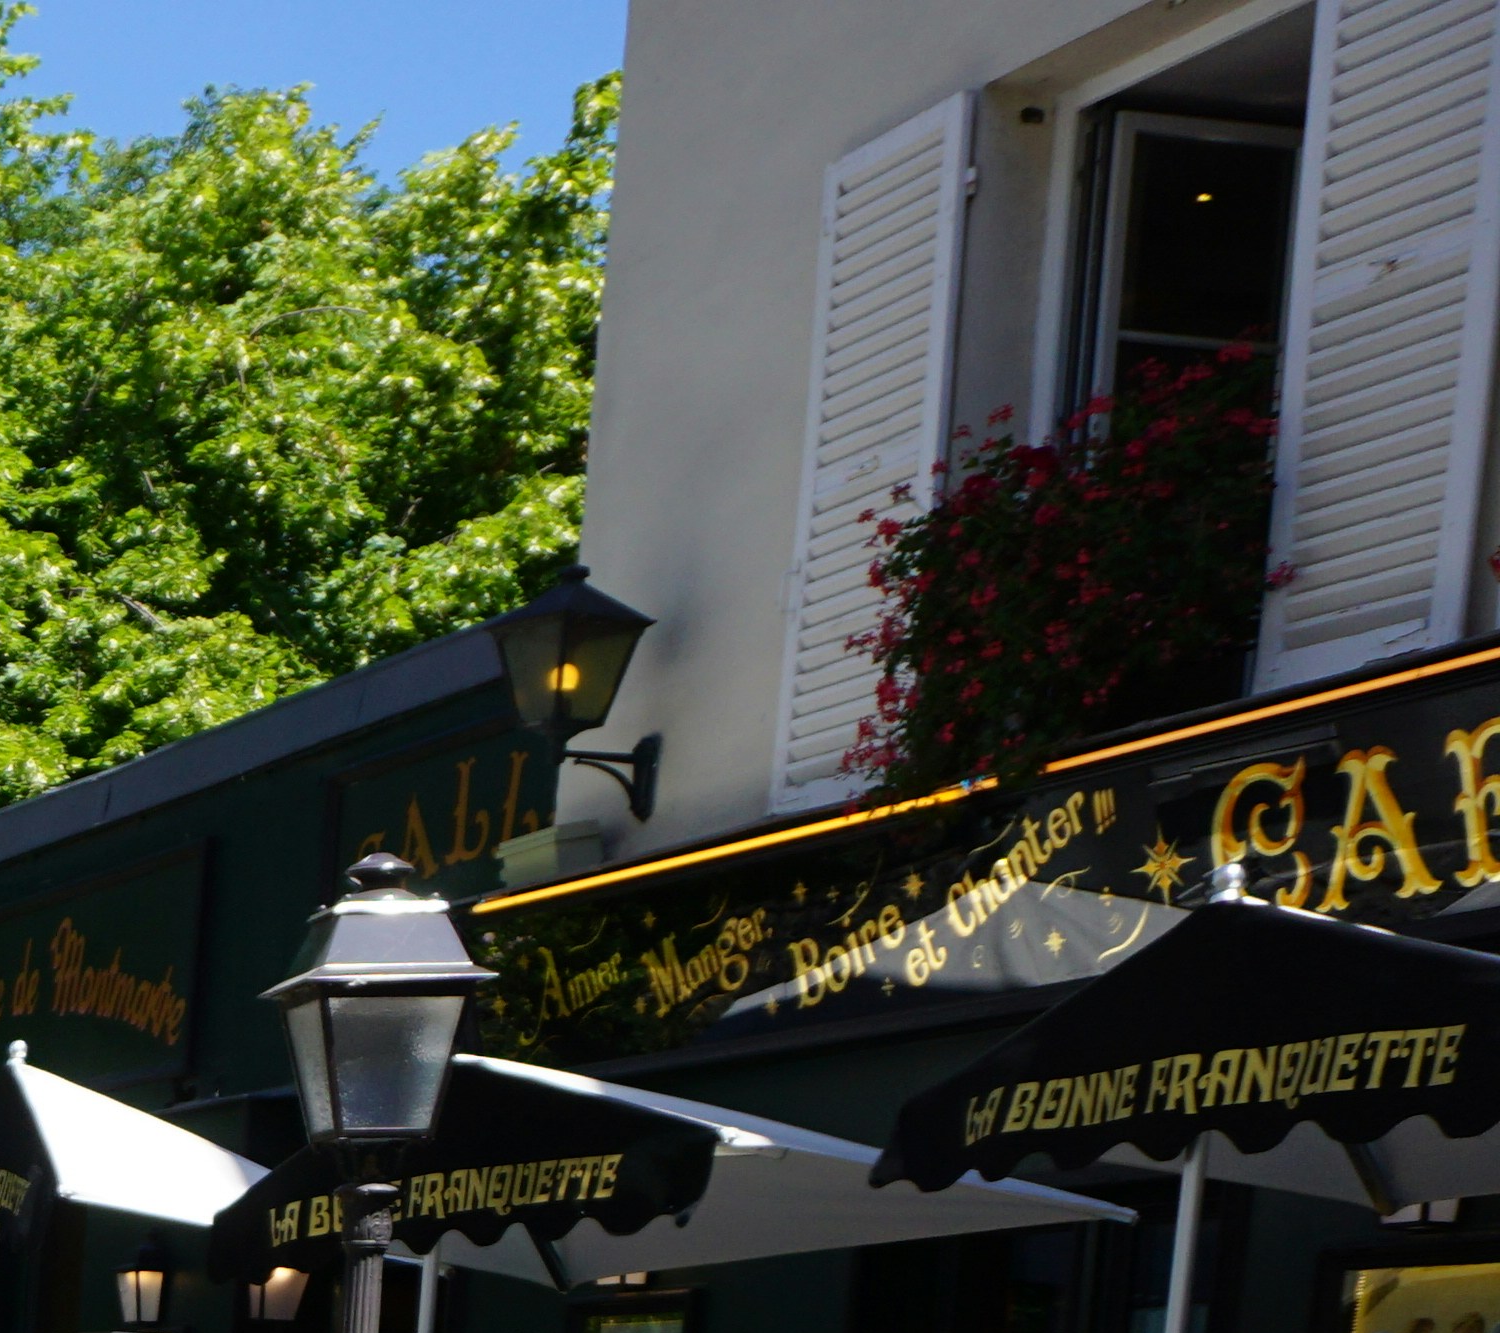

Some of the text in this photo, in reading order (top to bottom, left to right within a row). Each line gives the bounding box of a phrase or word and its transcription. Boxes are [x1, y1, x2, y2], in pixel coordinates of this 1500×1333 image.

[788, 903, 906, 1010] Boire
[904, 927, 947, 988] et
[946, 790, 1084, 939] Chanter
[11, 938, 40, 1016] de
[50, 916, 187, 1046] Montmartre
[964, 1024, 1468, 1147] LA BONNE FRANQUETTE
[269, 1200, 302, 1248] LA
[406, 1153, 624, 1219] FRANQUETTE
